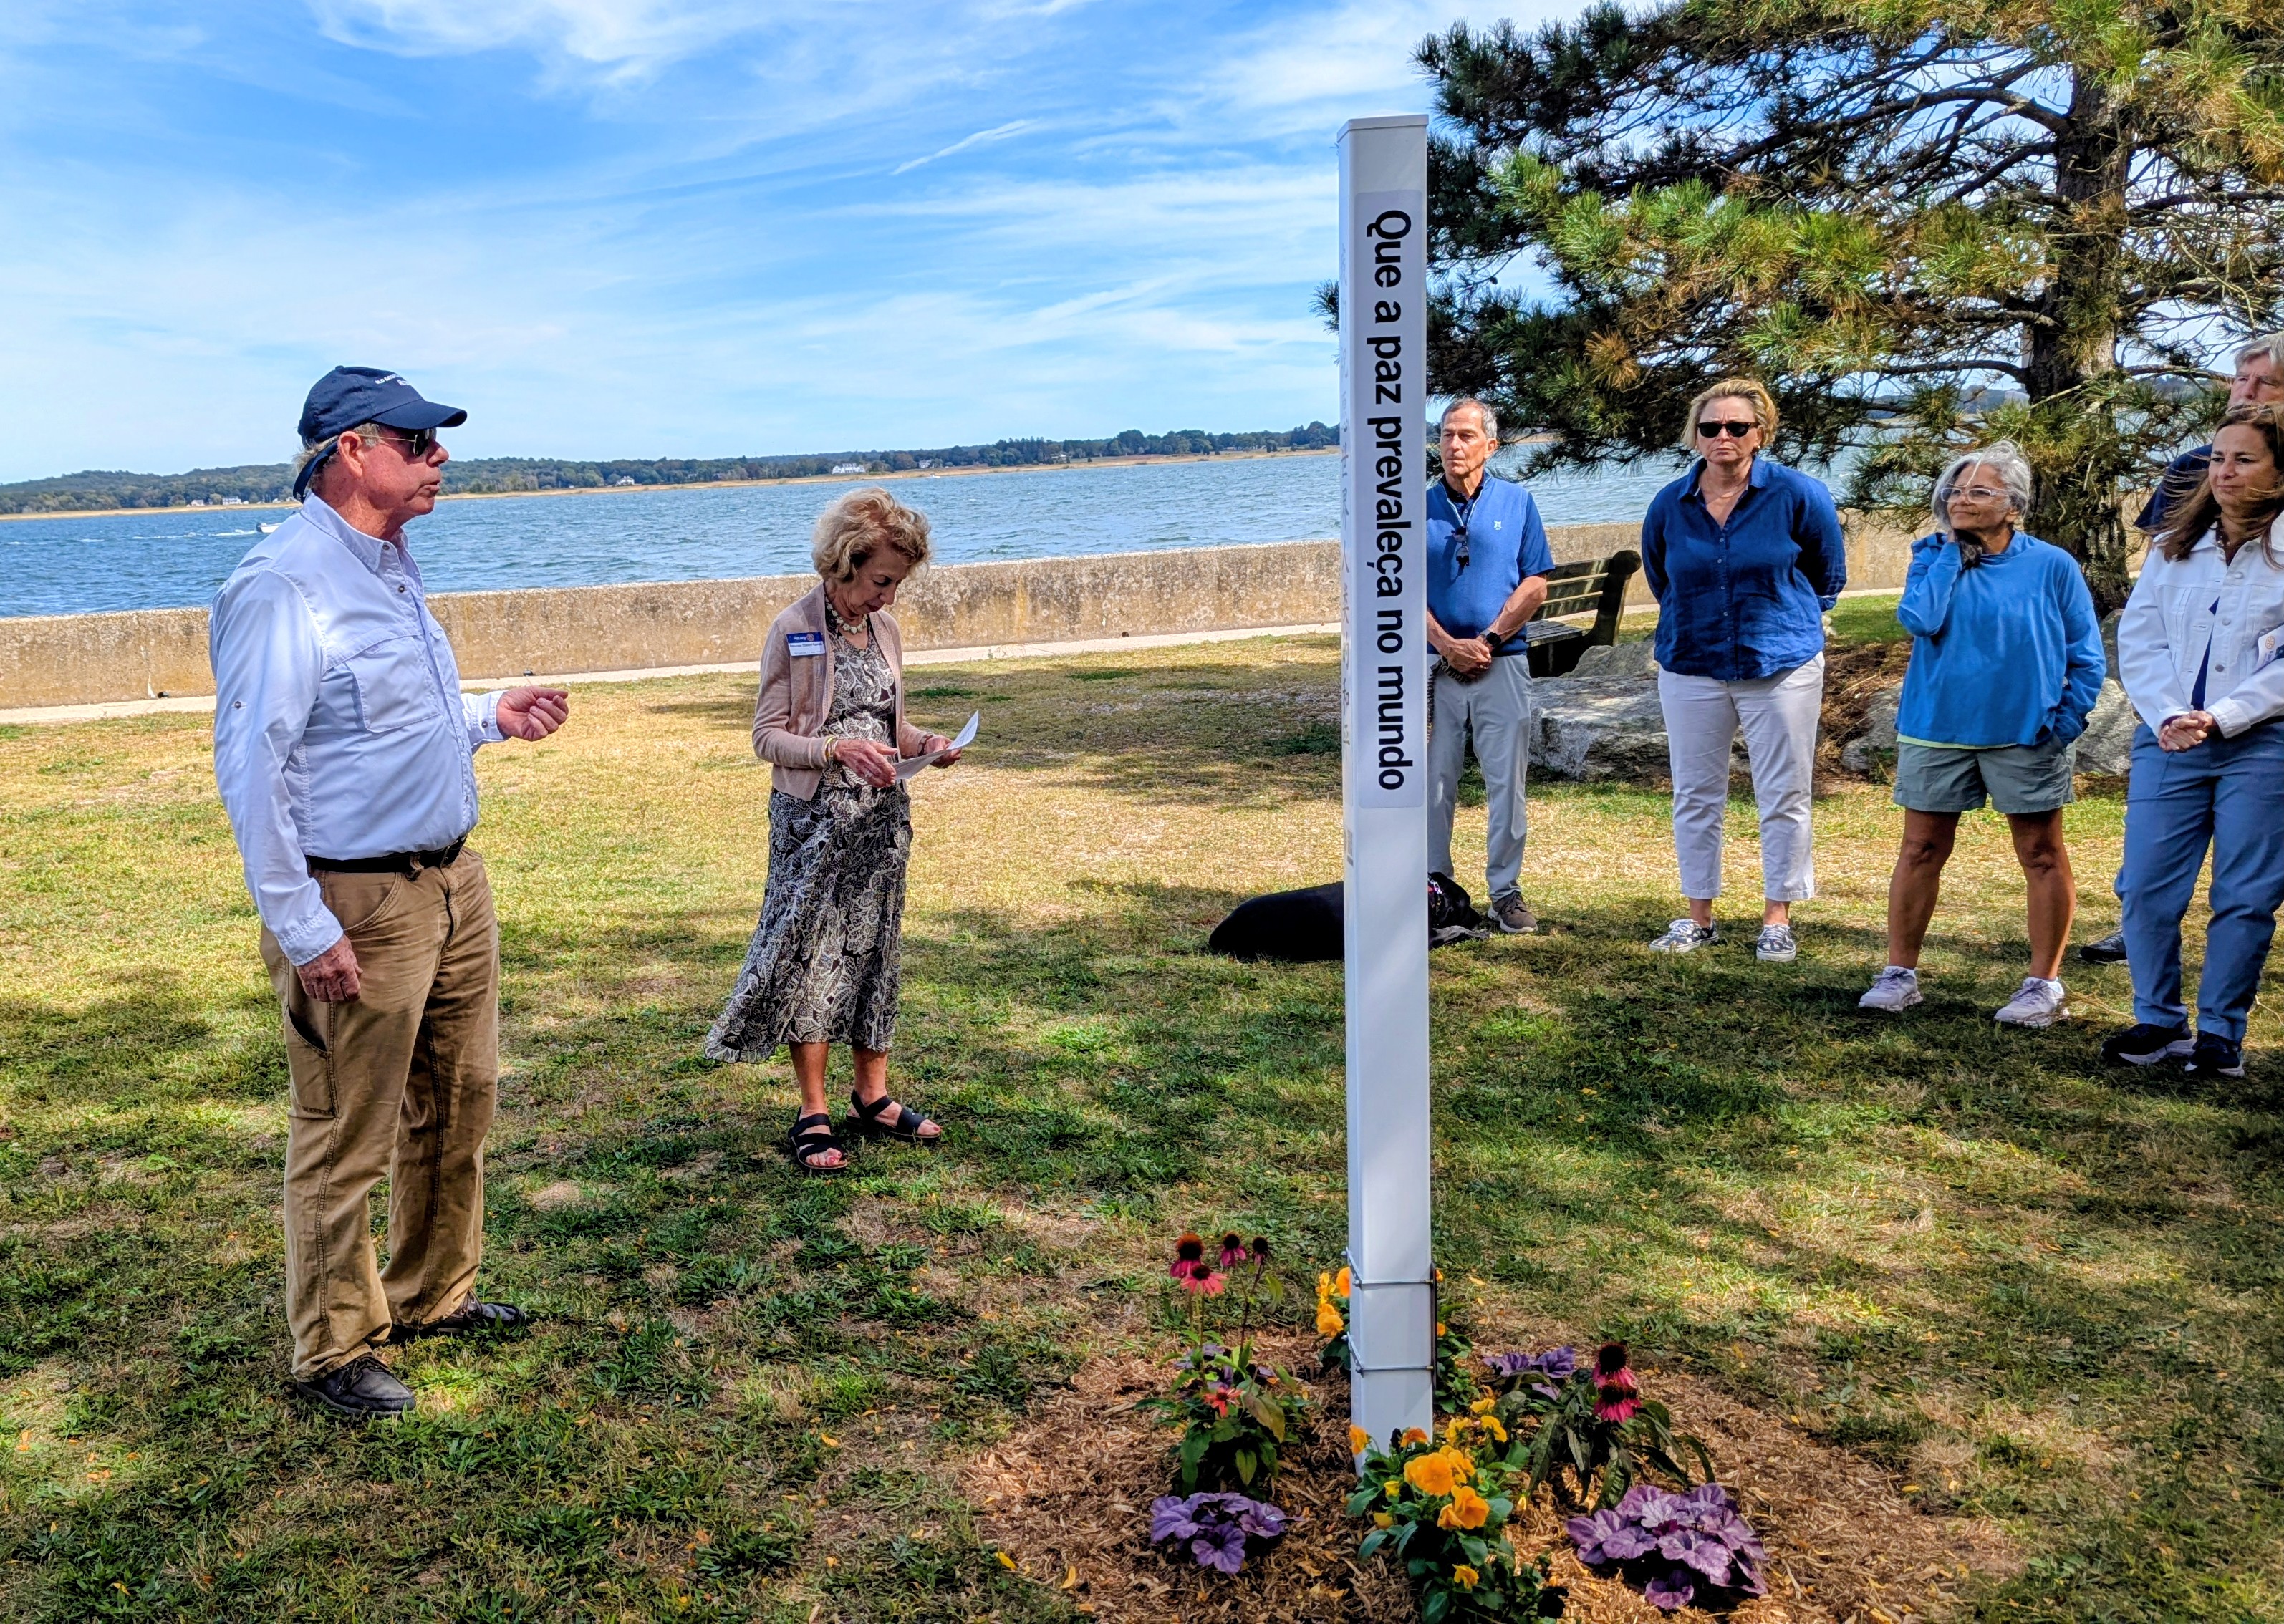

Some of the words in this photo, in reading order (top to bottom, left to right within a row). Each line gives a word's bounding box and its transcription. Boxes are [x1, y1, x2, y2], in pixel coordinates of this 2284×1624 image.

[1366, 210, 1412, 288] Que
[1374, 300, 1402, 324] a
[1366, 335, 1402, 405] paz
[1367, 416, 1412, 598] prevaleça
[1377, 609, 1404, 654] no
[1377, 665, 1413, 791] mundo
